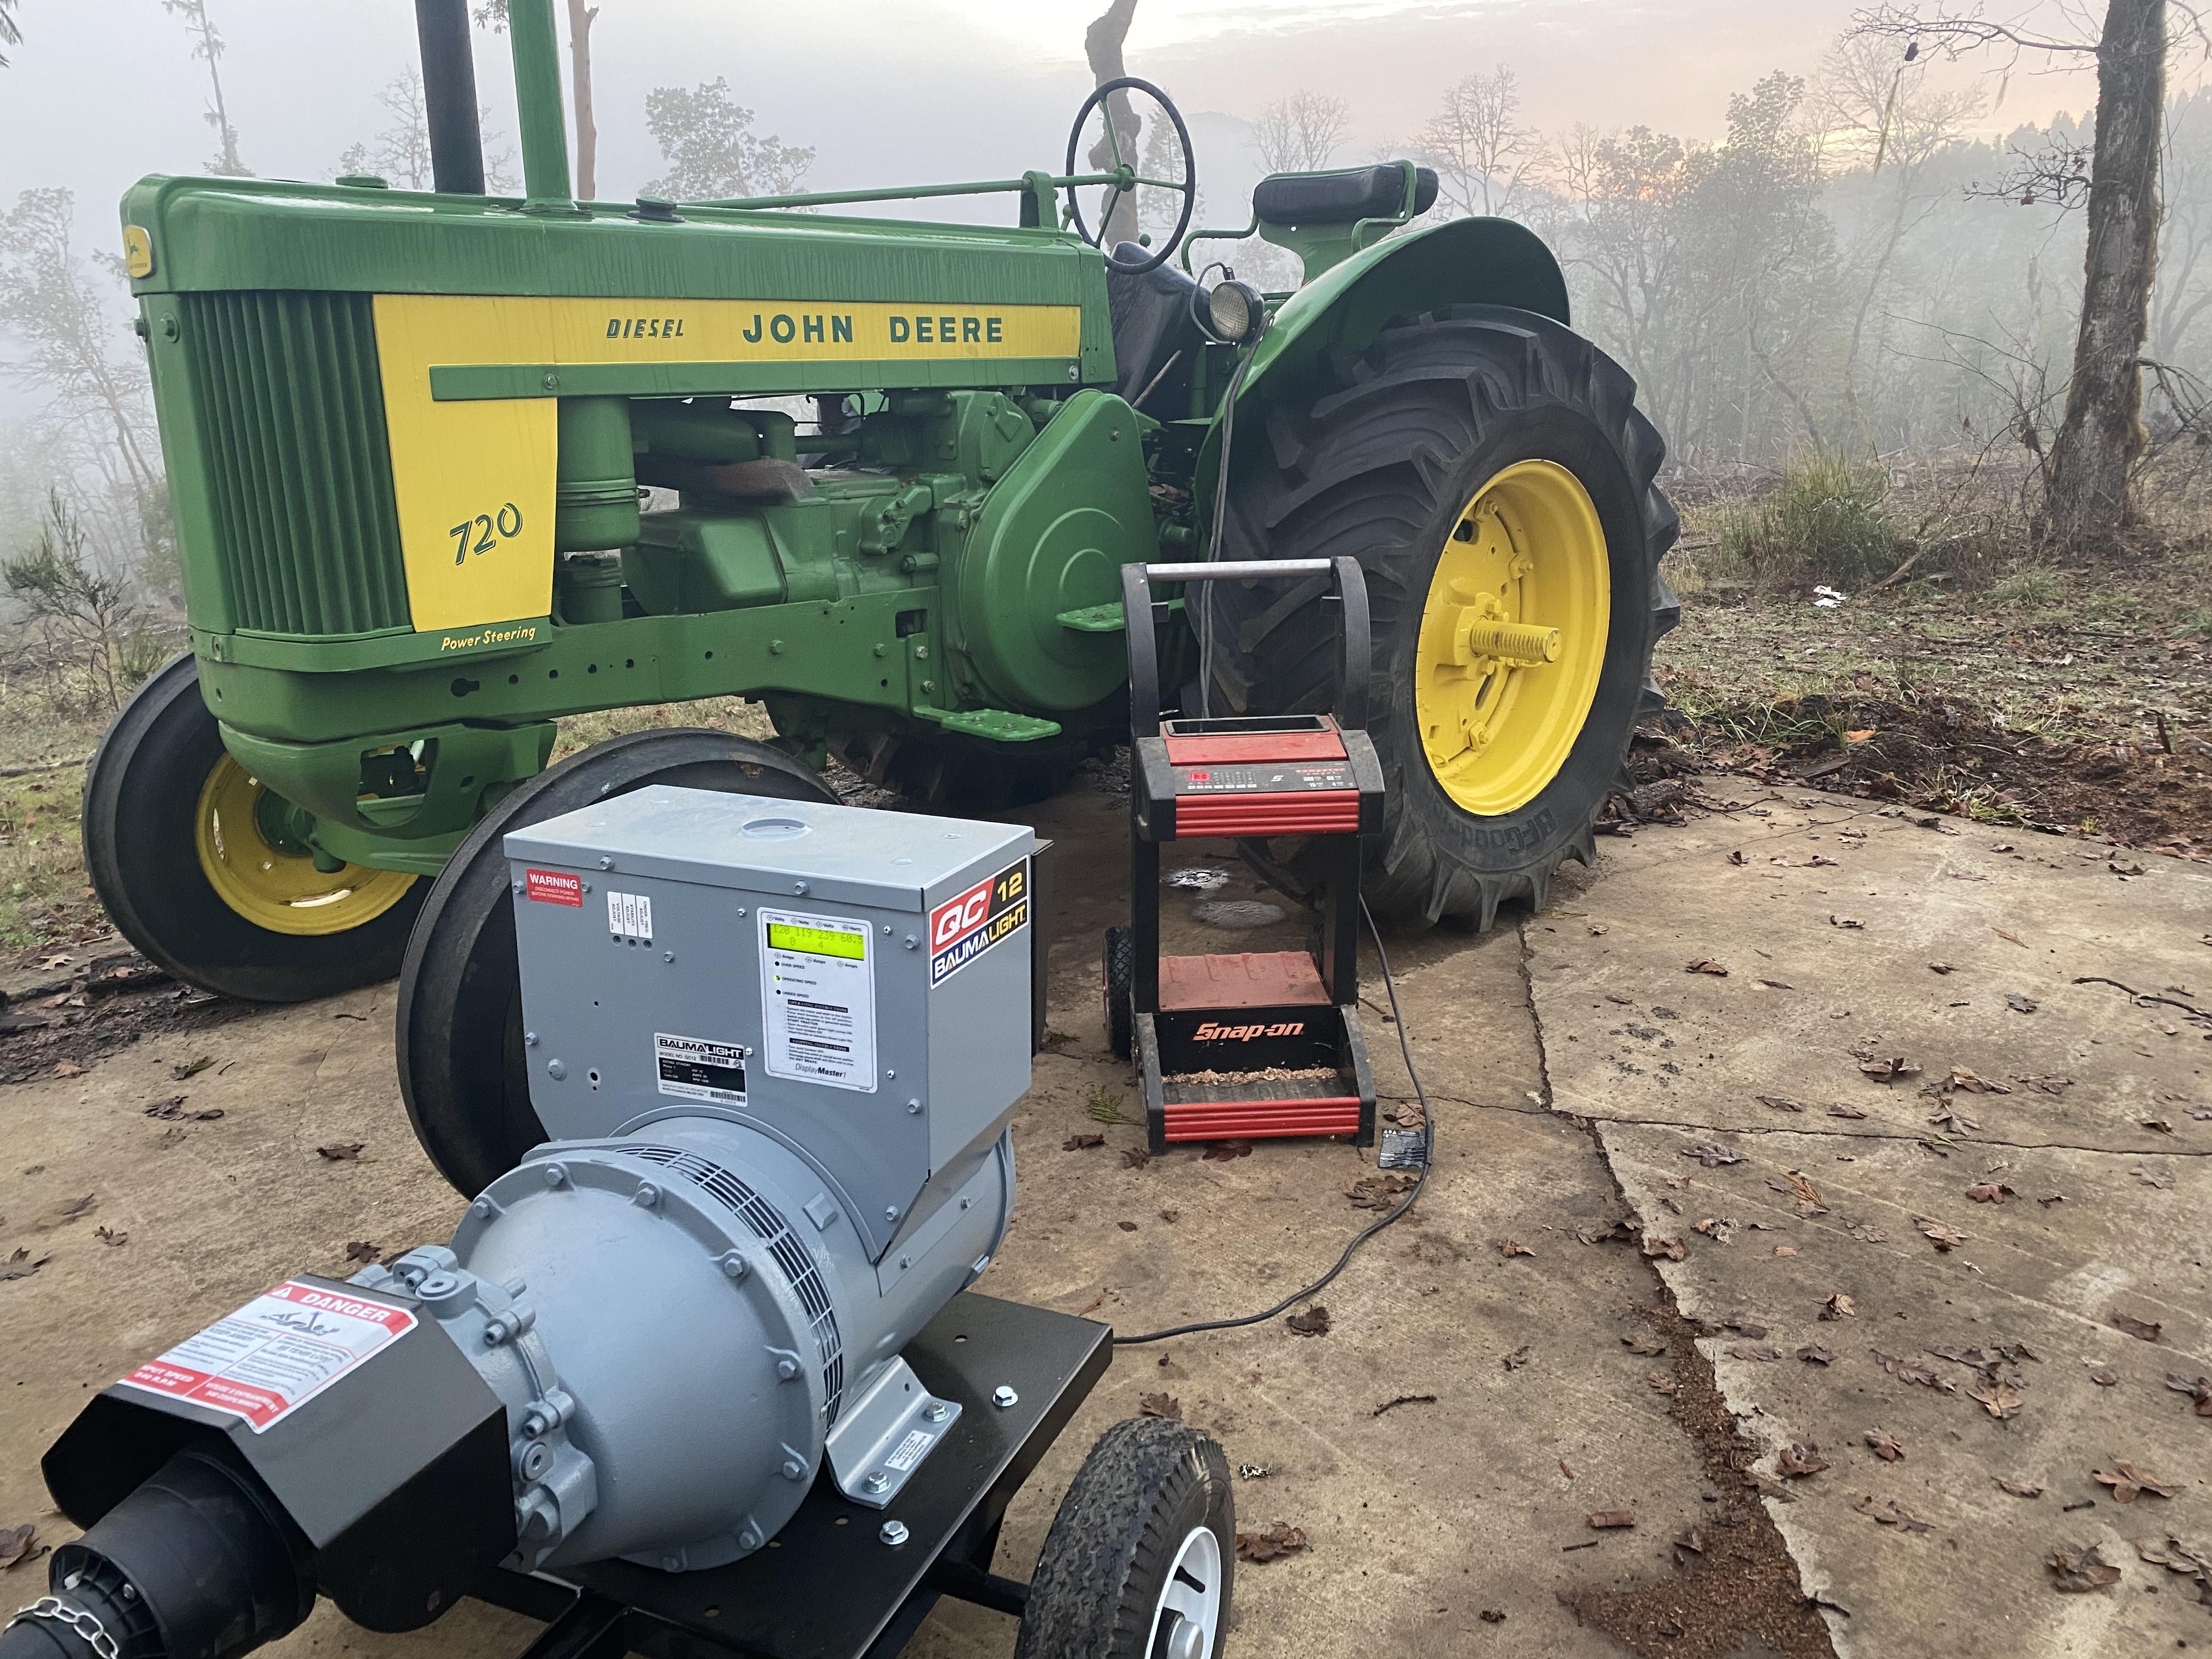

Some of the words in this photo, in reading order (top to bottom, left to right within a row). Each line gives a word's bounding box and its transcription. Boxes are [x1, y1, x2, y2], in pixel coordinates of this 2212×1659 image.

[606, 318, 685, 339] DIESEL
[743, 314, 853, 344] JOHN
[890, 316, 1003, 343] DEERE
[449, 502, 523, 566] 720
[441, 635, 481, 651] Power
[483, 626, 536, 644] Steering
[529, 874, 578, 890] WARNING
[935, 890, 987, 946] QC
[997, 872, 1023, 902] 12
[774, 924, 790, 934] 120
[796, 928, 812, 937] 119
[819, 930, 835, 940] 239
[790, 936, 795, 946] 0
[935, 904, 1025, 979] BAUMALIGHT
[1193, 1022, 1304, 1041] Snap-on
[659, 1039, 742, 1058] BAUMALIGHT
[300, 1293, 391, 1322] DANGER
[164, 1371, 195, 1383] SPEED
